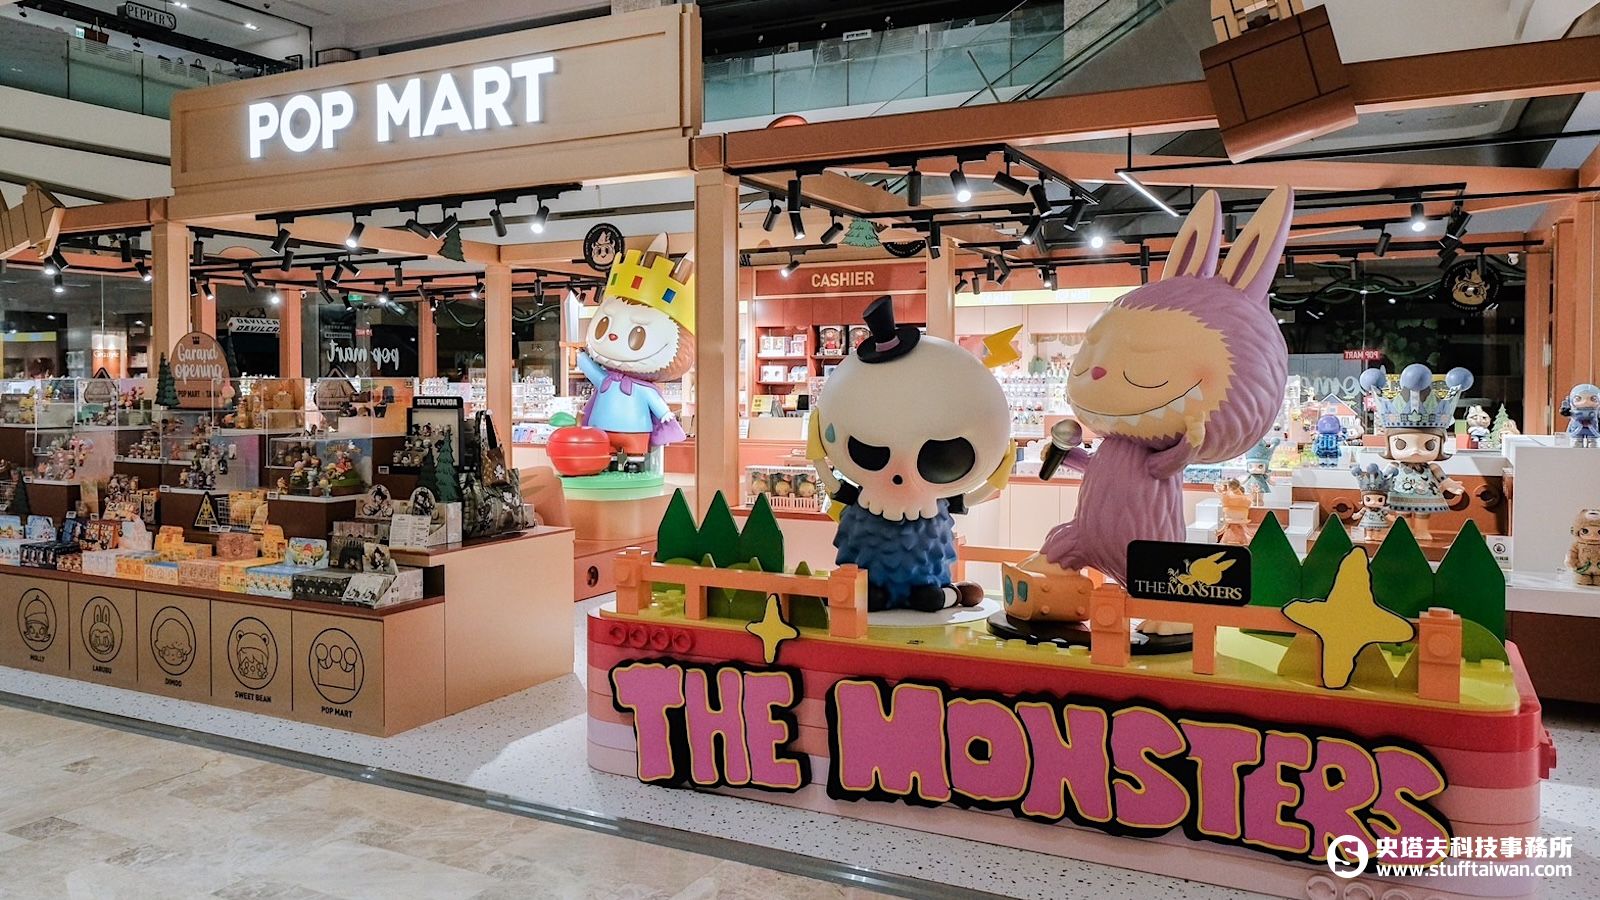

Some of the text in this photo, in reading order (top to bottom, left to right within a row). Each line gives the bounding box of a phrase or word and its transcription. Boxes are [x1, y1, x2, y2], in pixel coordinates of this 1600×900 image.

[249, 56, 554, 158] POP MART
[811, 270, 875, 287] CASHIER
[177, 343, 219, 362] Garand
[175, 361, 224, 384] opening
[416, 398, 458, 406] SKULLPANDA
[1135, 580, 1243, 600] THE MONSTERS
[234, 690, 272, 703] SWEET BEAN
[321, 705, 353, 718] POP MART
[611, 662, 1452, 868] THE MONSTERS
